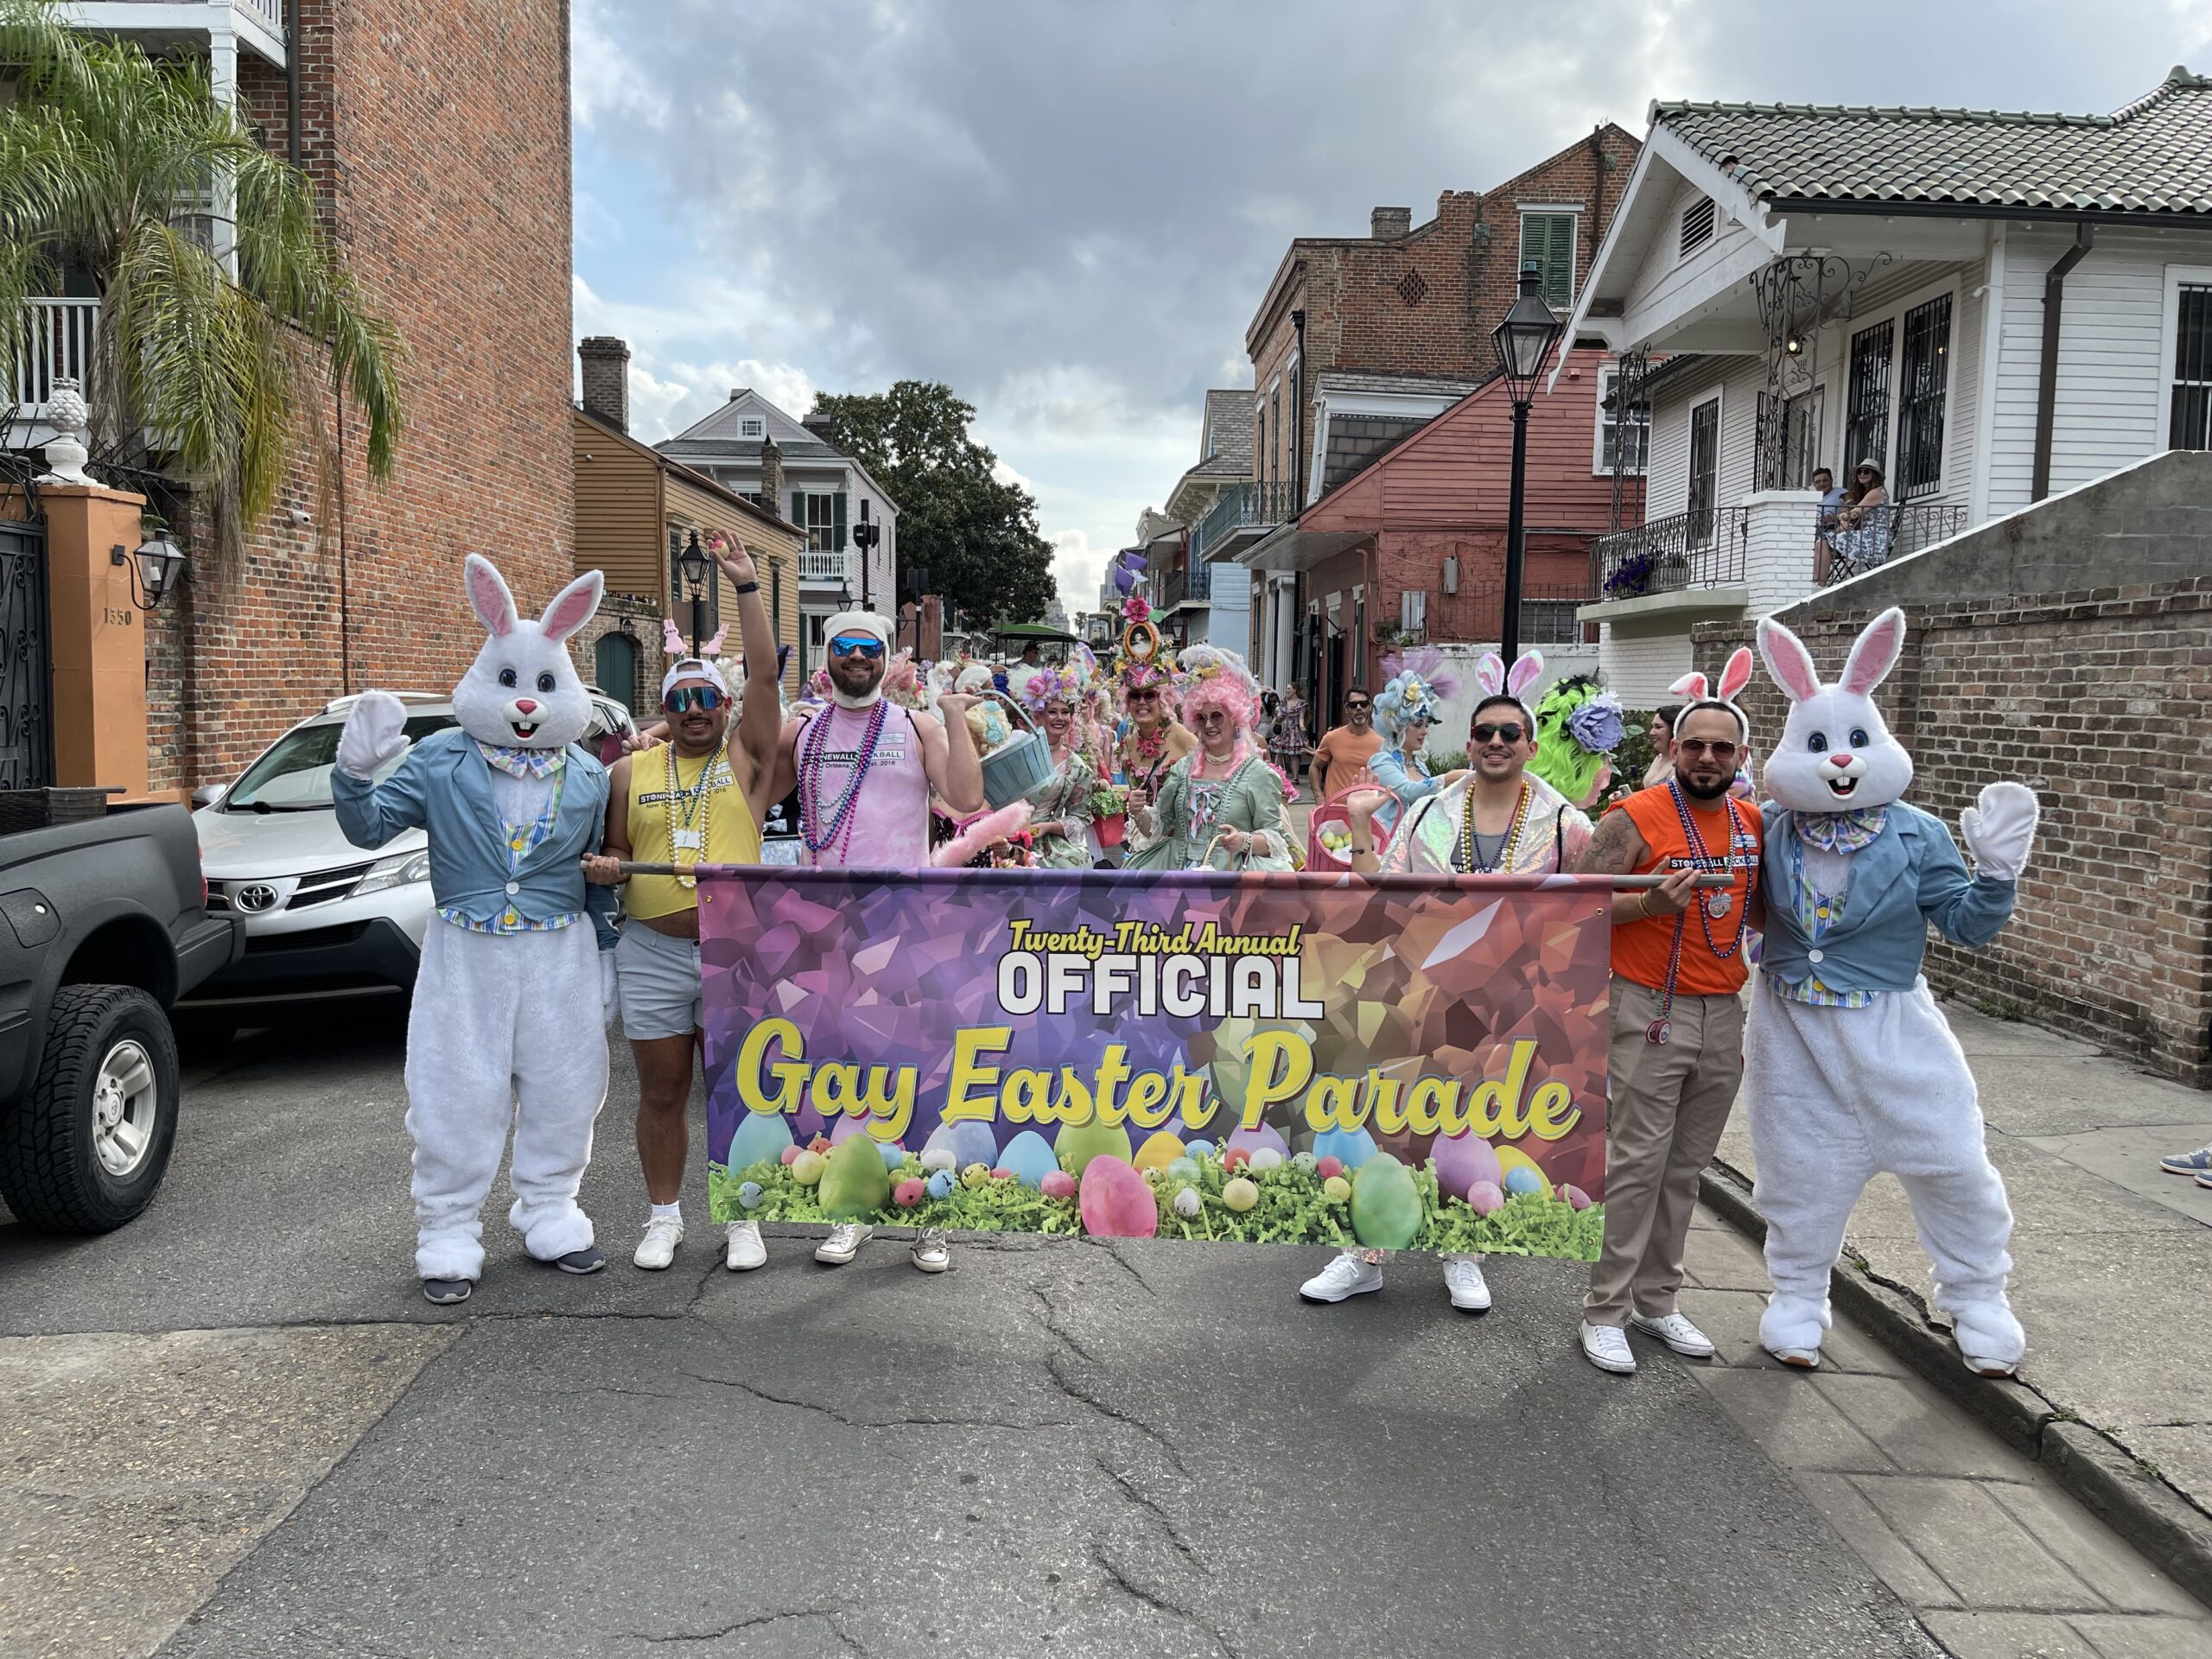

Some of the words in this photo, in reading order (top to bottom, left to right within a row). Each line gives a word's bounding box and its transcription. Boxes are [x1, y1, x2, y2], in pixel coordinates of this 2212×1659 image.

[1008, 918, 1193, 960] Twenty-Third
[1197, 922, 1302, 957] Annual
[996, 950, 1325, 1020] OFFICIAL
[735, 1016, 918, 1143] Gay
[938, 1024, 1220, 1130] Easter
[1239, 1027, 1582, 1140] Parade
